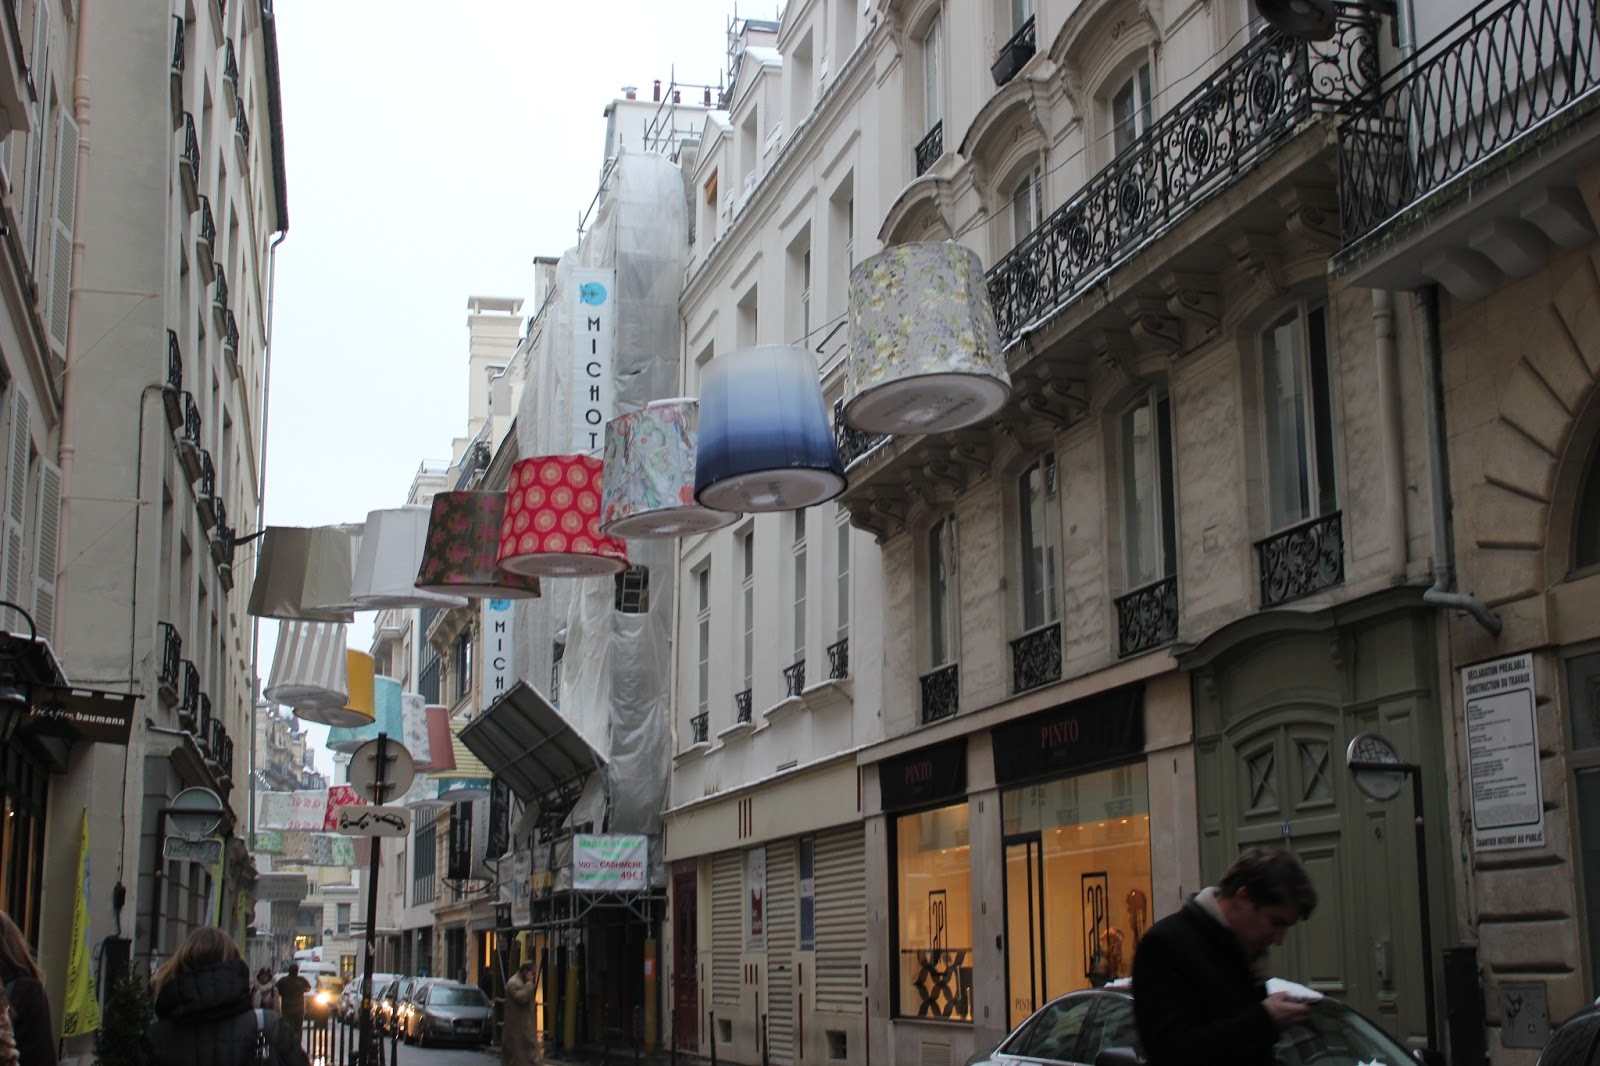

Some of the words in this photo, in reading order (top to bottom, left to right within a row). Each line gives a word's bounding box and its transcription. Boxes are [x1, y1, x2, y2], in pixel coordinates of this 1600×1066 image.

[1499, 659, 1526, 674] PRÉALABLE
[1466, 680, 1500, 695] CONSTRUCTION
[1509, 673, 1530, 686] TRAVAUX
[76, 712, 125, 726] baumann
[1041, 719, 1079, 749] PINTO
[905, 760, 933, 785] PINTO
[1476, 836, 1497, 847] CHANTIER
[1497, 835, 1517, 845] INTERDIT
[1518, 834, 1524, 843] AU
[1525, 832, 1542, 842] PUBLIC
[600, 861, 643, 869] CASHMERE
